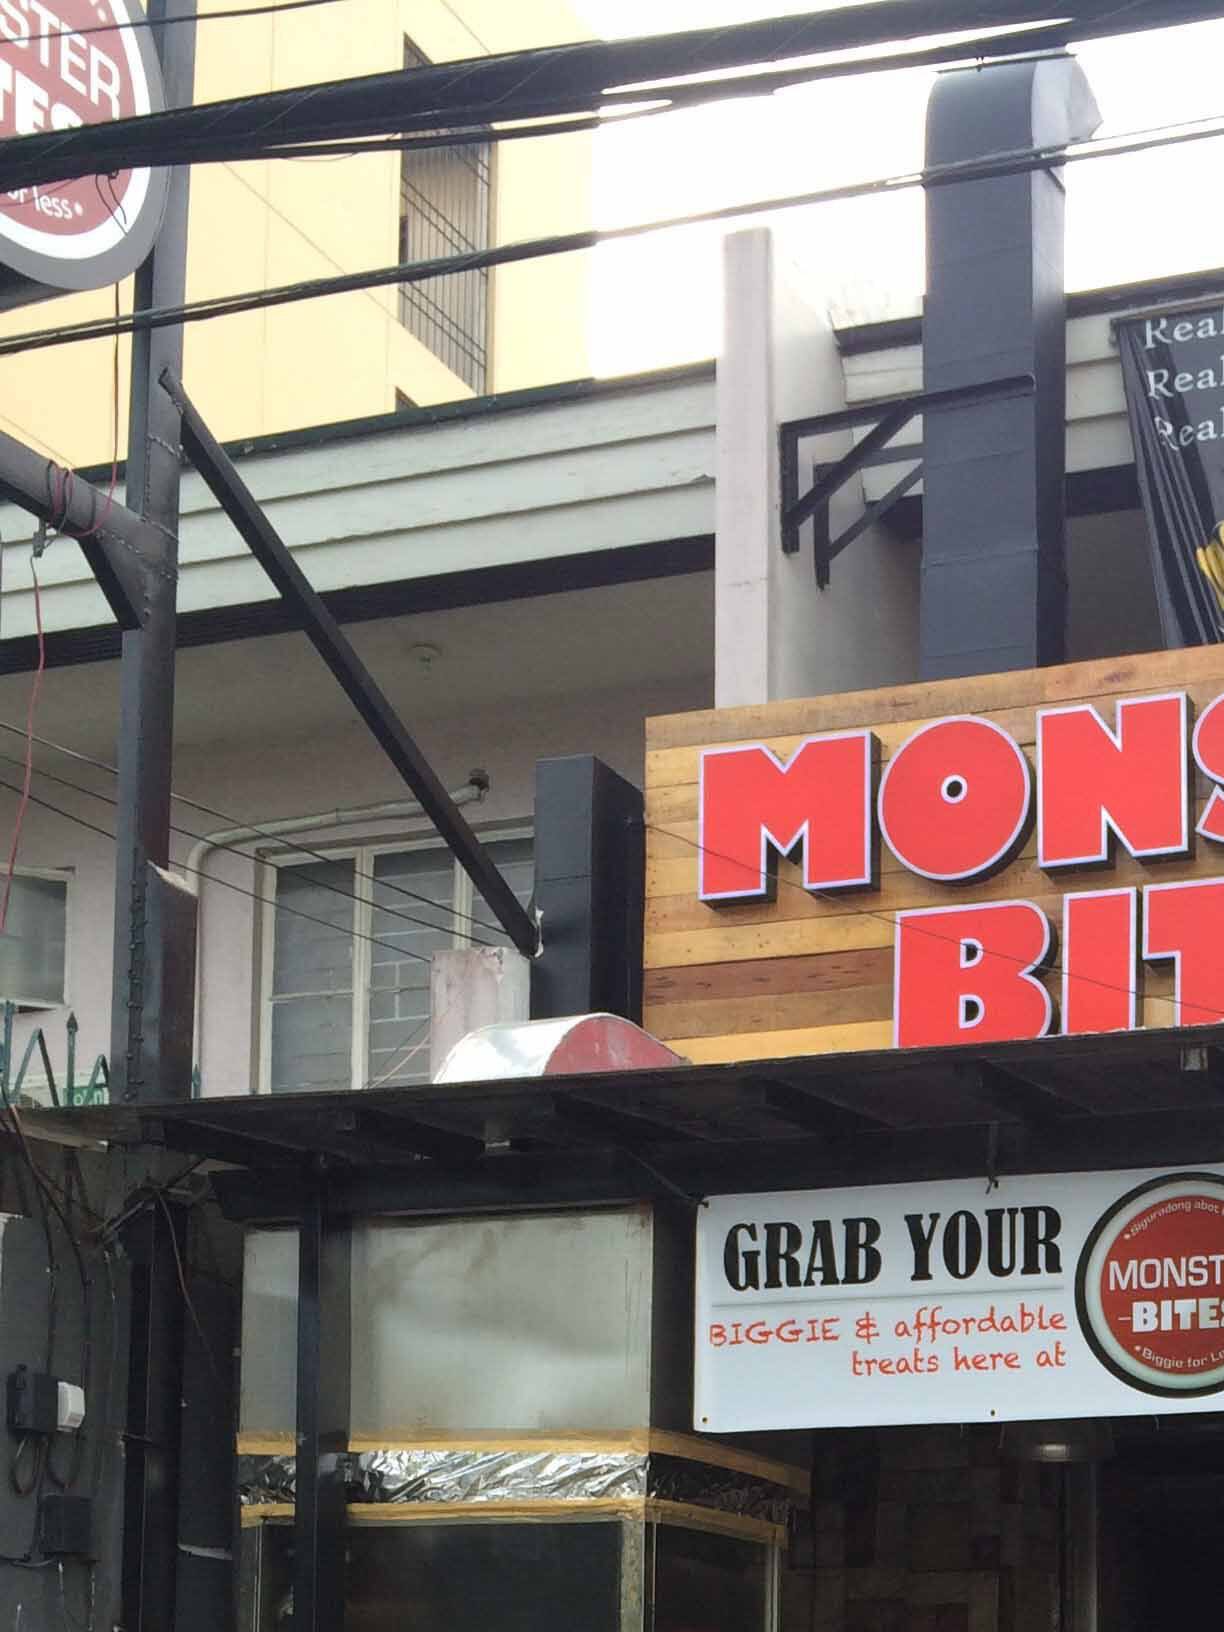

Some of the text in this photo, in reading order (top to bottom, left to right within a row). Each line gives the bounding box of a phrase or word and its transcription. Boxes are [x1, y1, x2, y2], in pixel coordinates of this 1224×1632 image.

[723, 1205, 1063, 1292] GRAB YOUR
[709, 1302, 1068, 1347] BIGGIE & affordable
[851, 1340, 1067, 1376] treats here at
